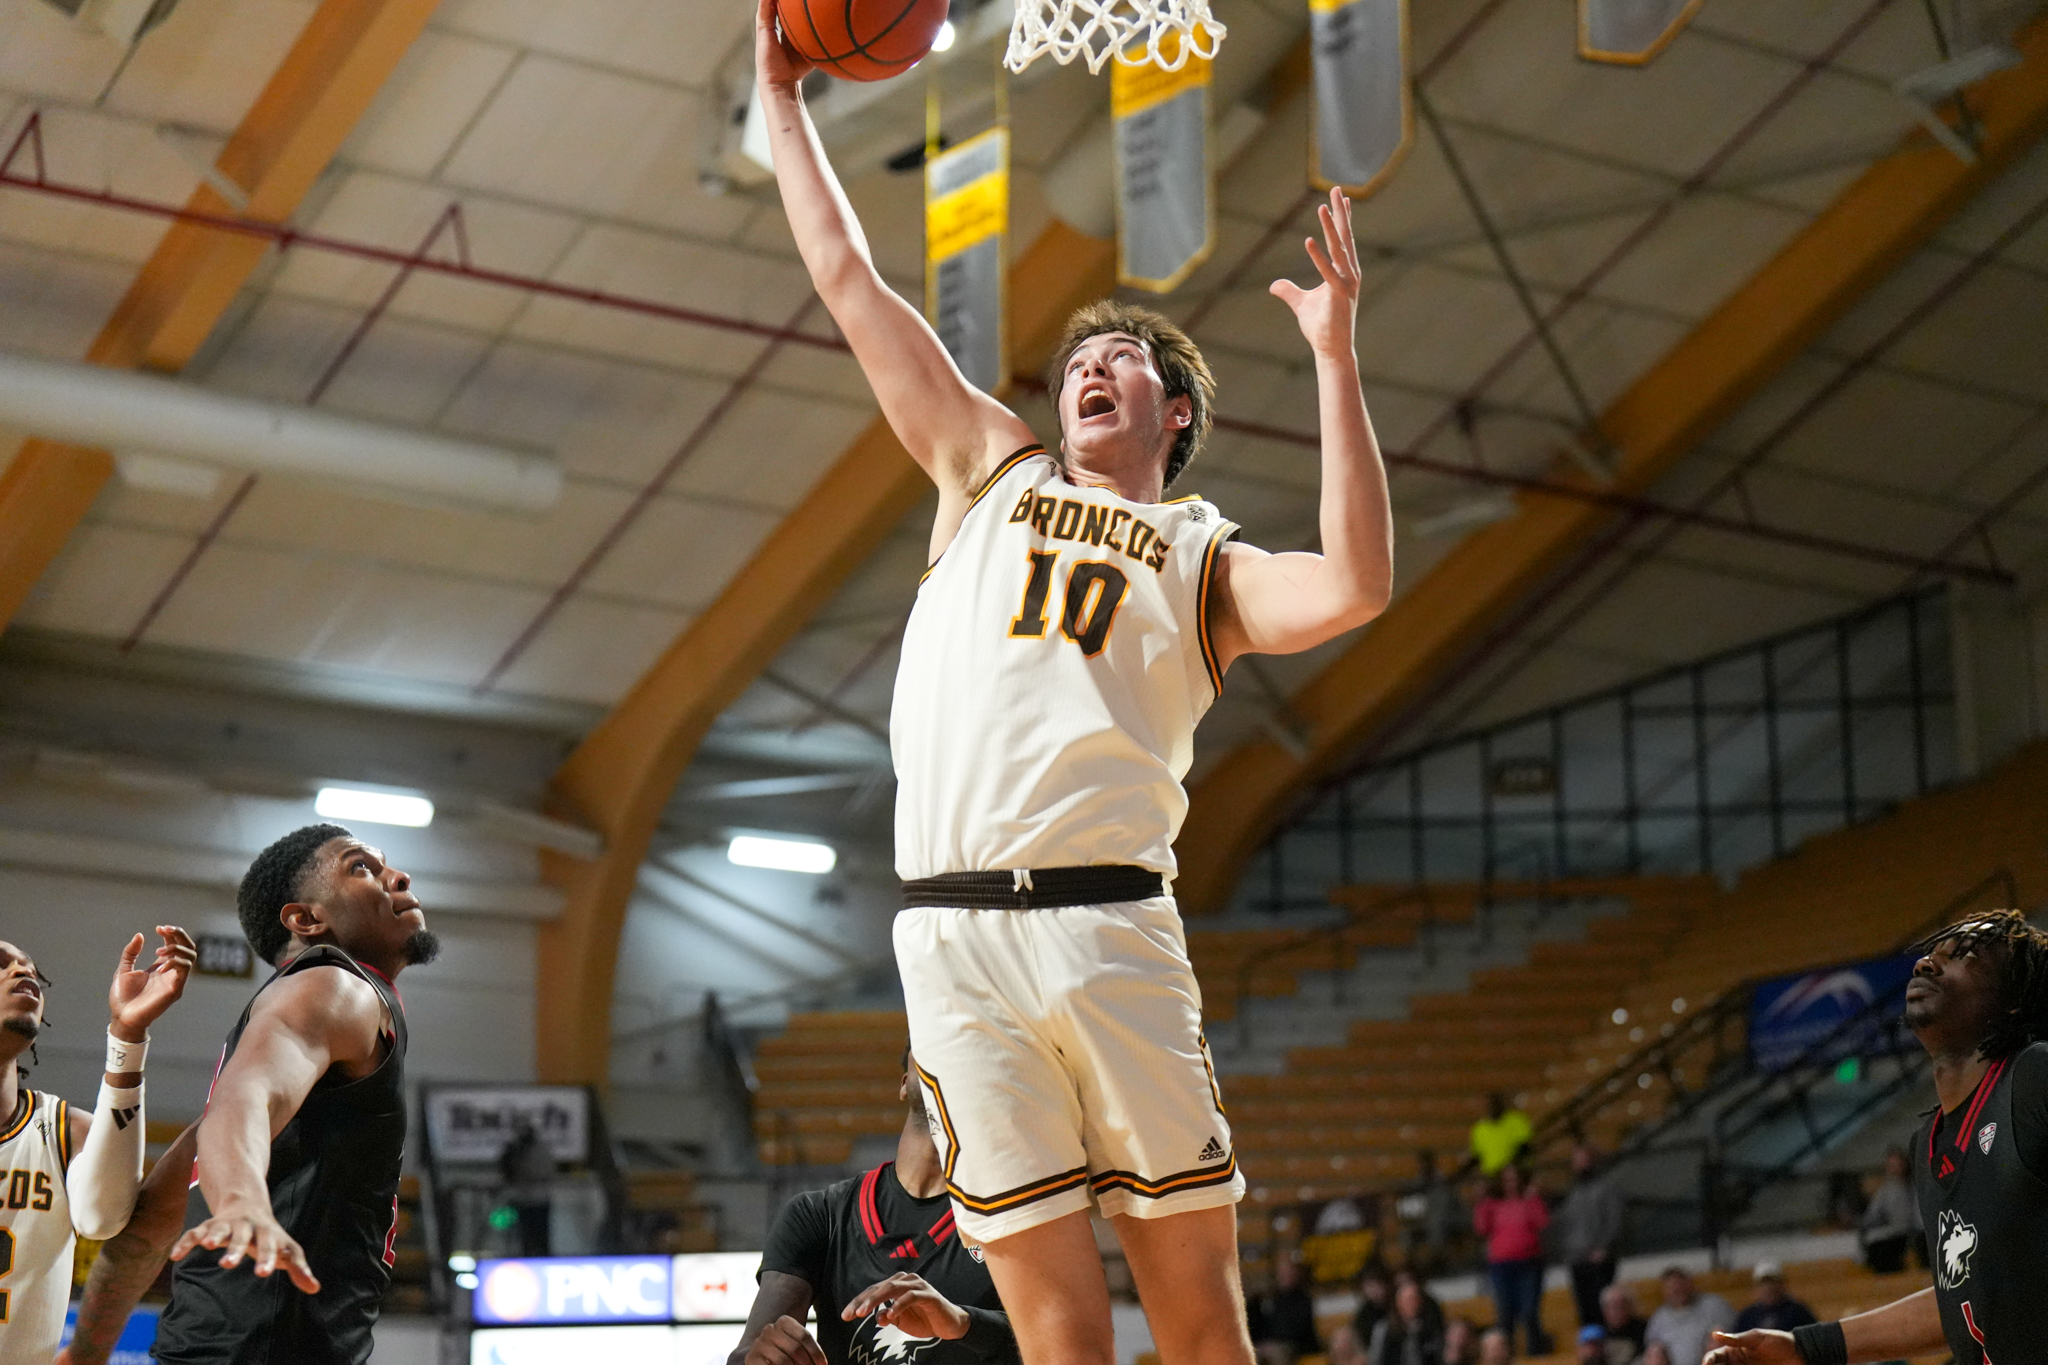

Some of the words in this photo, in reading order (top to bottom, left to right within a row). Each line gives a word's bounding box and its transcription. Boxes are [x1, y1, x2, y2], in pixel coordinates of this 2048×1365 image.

[1008, 487, 1172, 574] BRONCOS
[1007, 548, 1131, 660] 10
[1198, 1150, 1226, 1161] adidas
[546, 1262, 668, 1316] PNC
